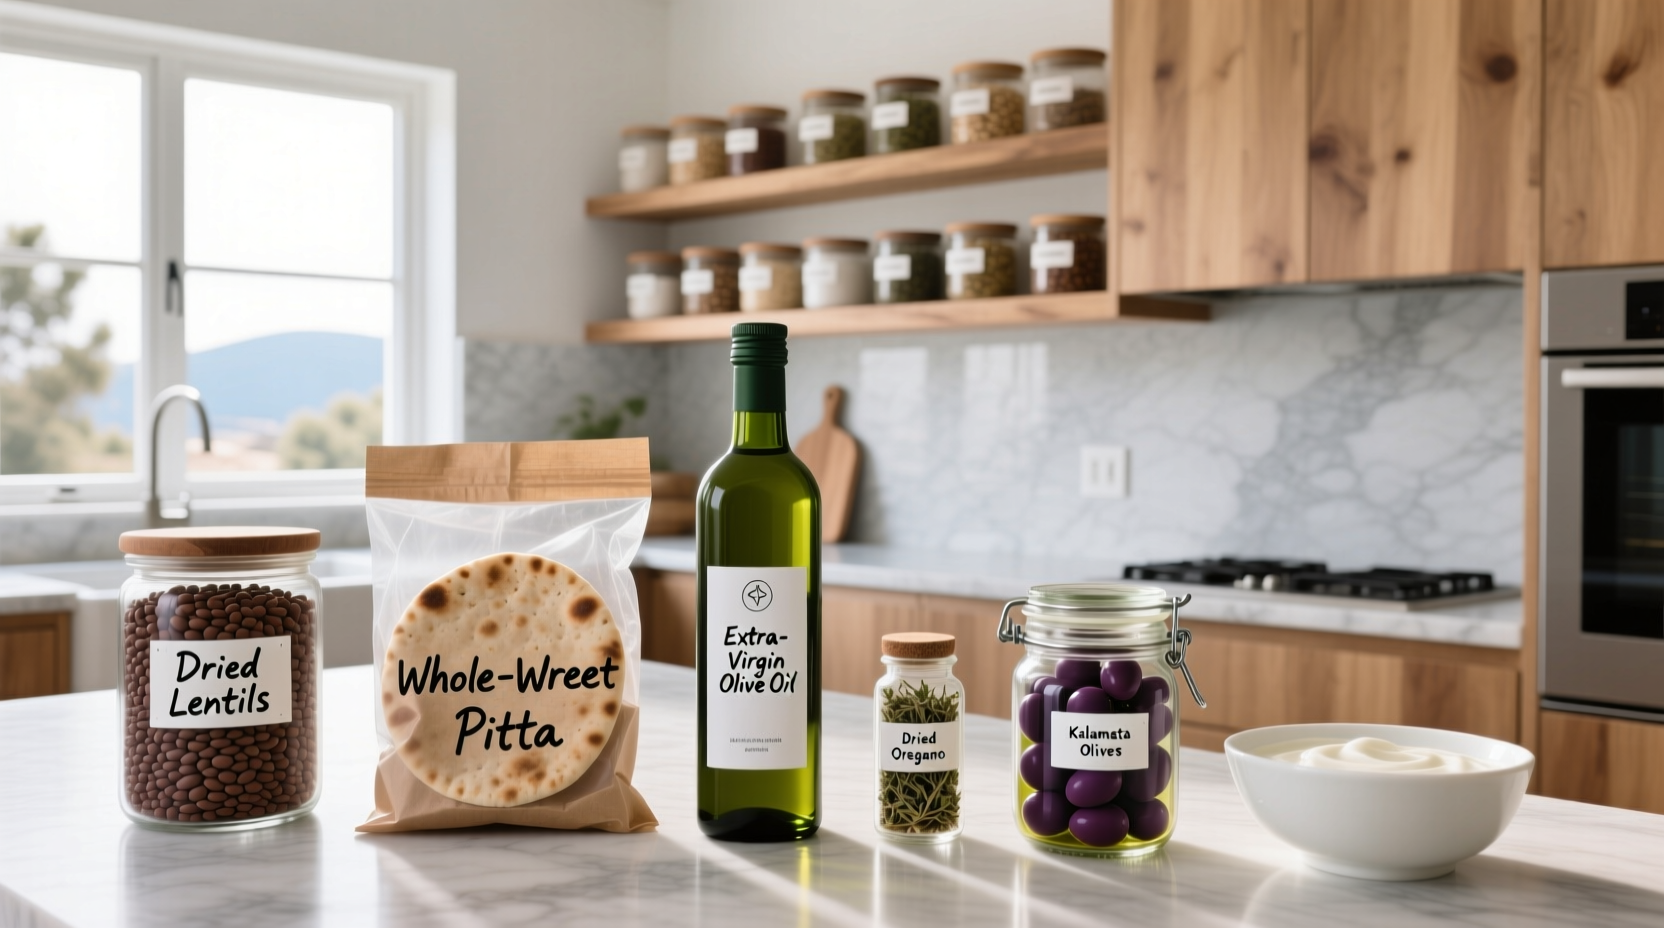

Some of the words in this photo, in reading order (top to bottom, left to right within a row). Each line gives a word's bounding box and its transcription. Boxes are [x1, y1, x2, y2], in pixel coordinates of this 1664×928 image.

[723, 625, 789, 647] Extra-
[176, 646, 262, 683] Dried
[398, 653, 620, 696] Whole-Wreet
[728, 650, 785, 679] Virgin
[719, 672, 766, 693] Olive
[769, 671, 798, 693] Oil
[169, 682, 270, 717] Lentils
[455, 706, 564, 756] Pitta
[902, 731, 937, 745] Dried
[891, 747, 946, 766] Oregano
[1080, 743, 1122, 757] Olives
